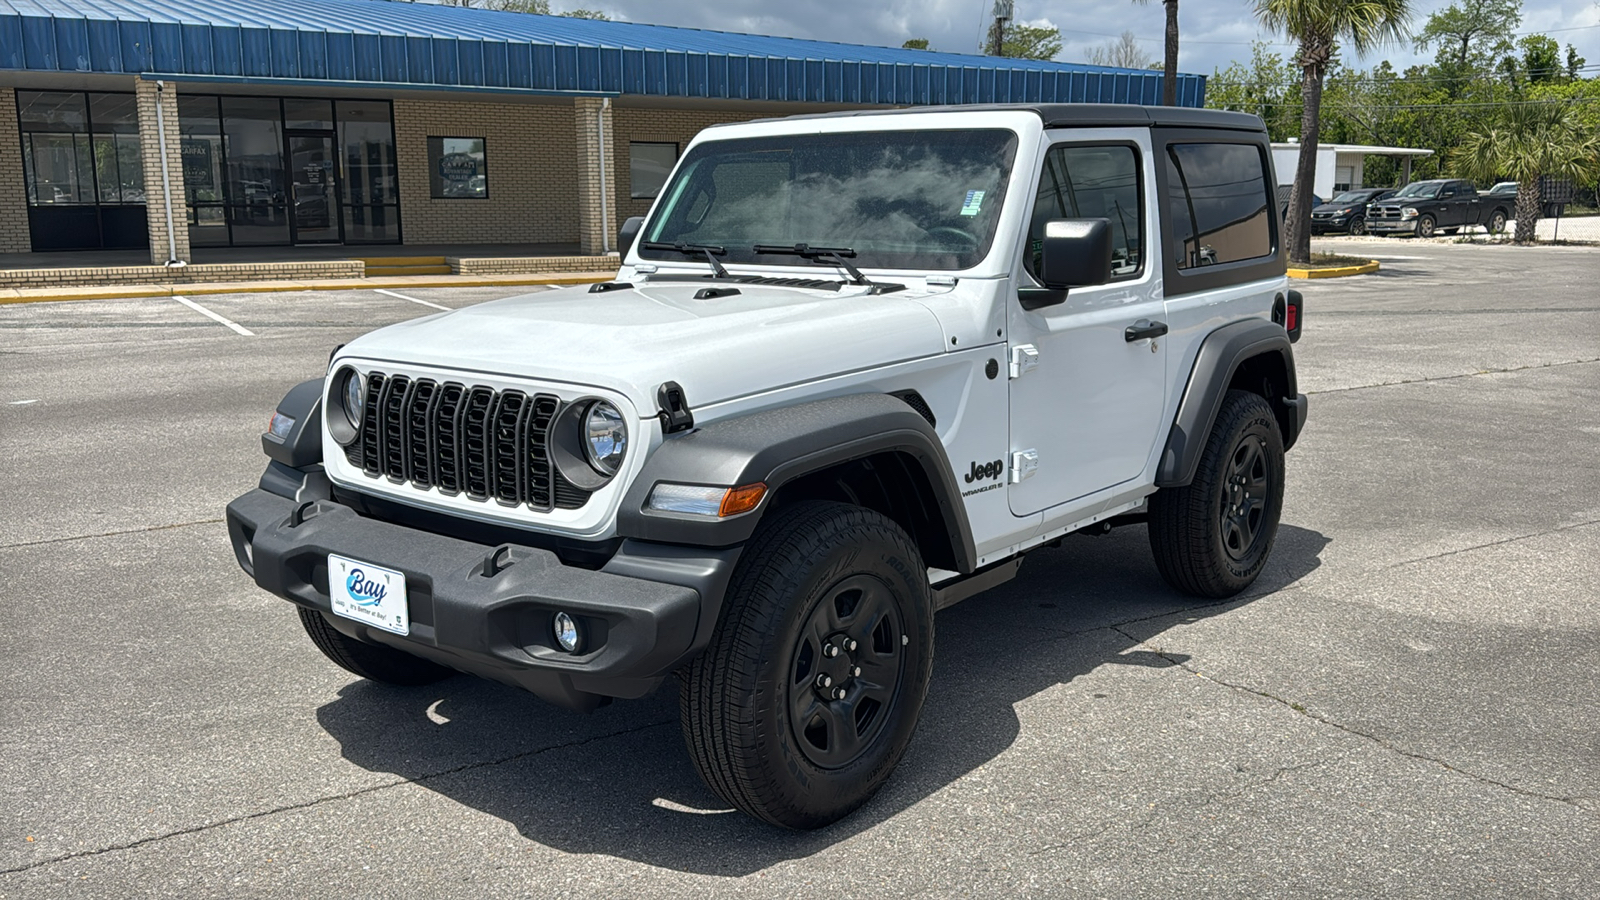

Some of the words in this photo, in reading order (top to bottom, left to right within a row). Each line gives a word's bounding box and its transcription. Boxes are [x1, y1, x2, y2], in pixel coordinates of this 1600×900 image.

[964, 459, 1003, 483] Jeep
[962, 484, 997, 497] WRANGLER
[349, 568, 387, 606] Bay
[357, 606, 371, 616] Better
